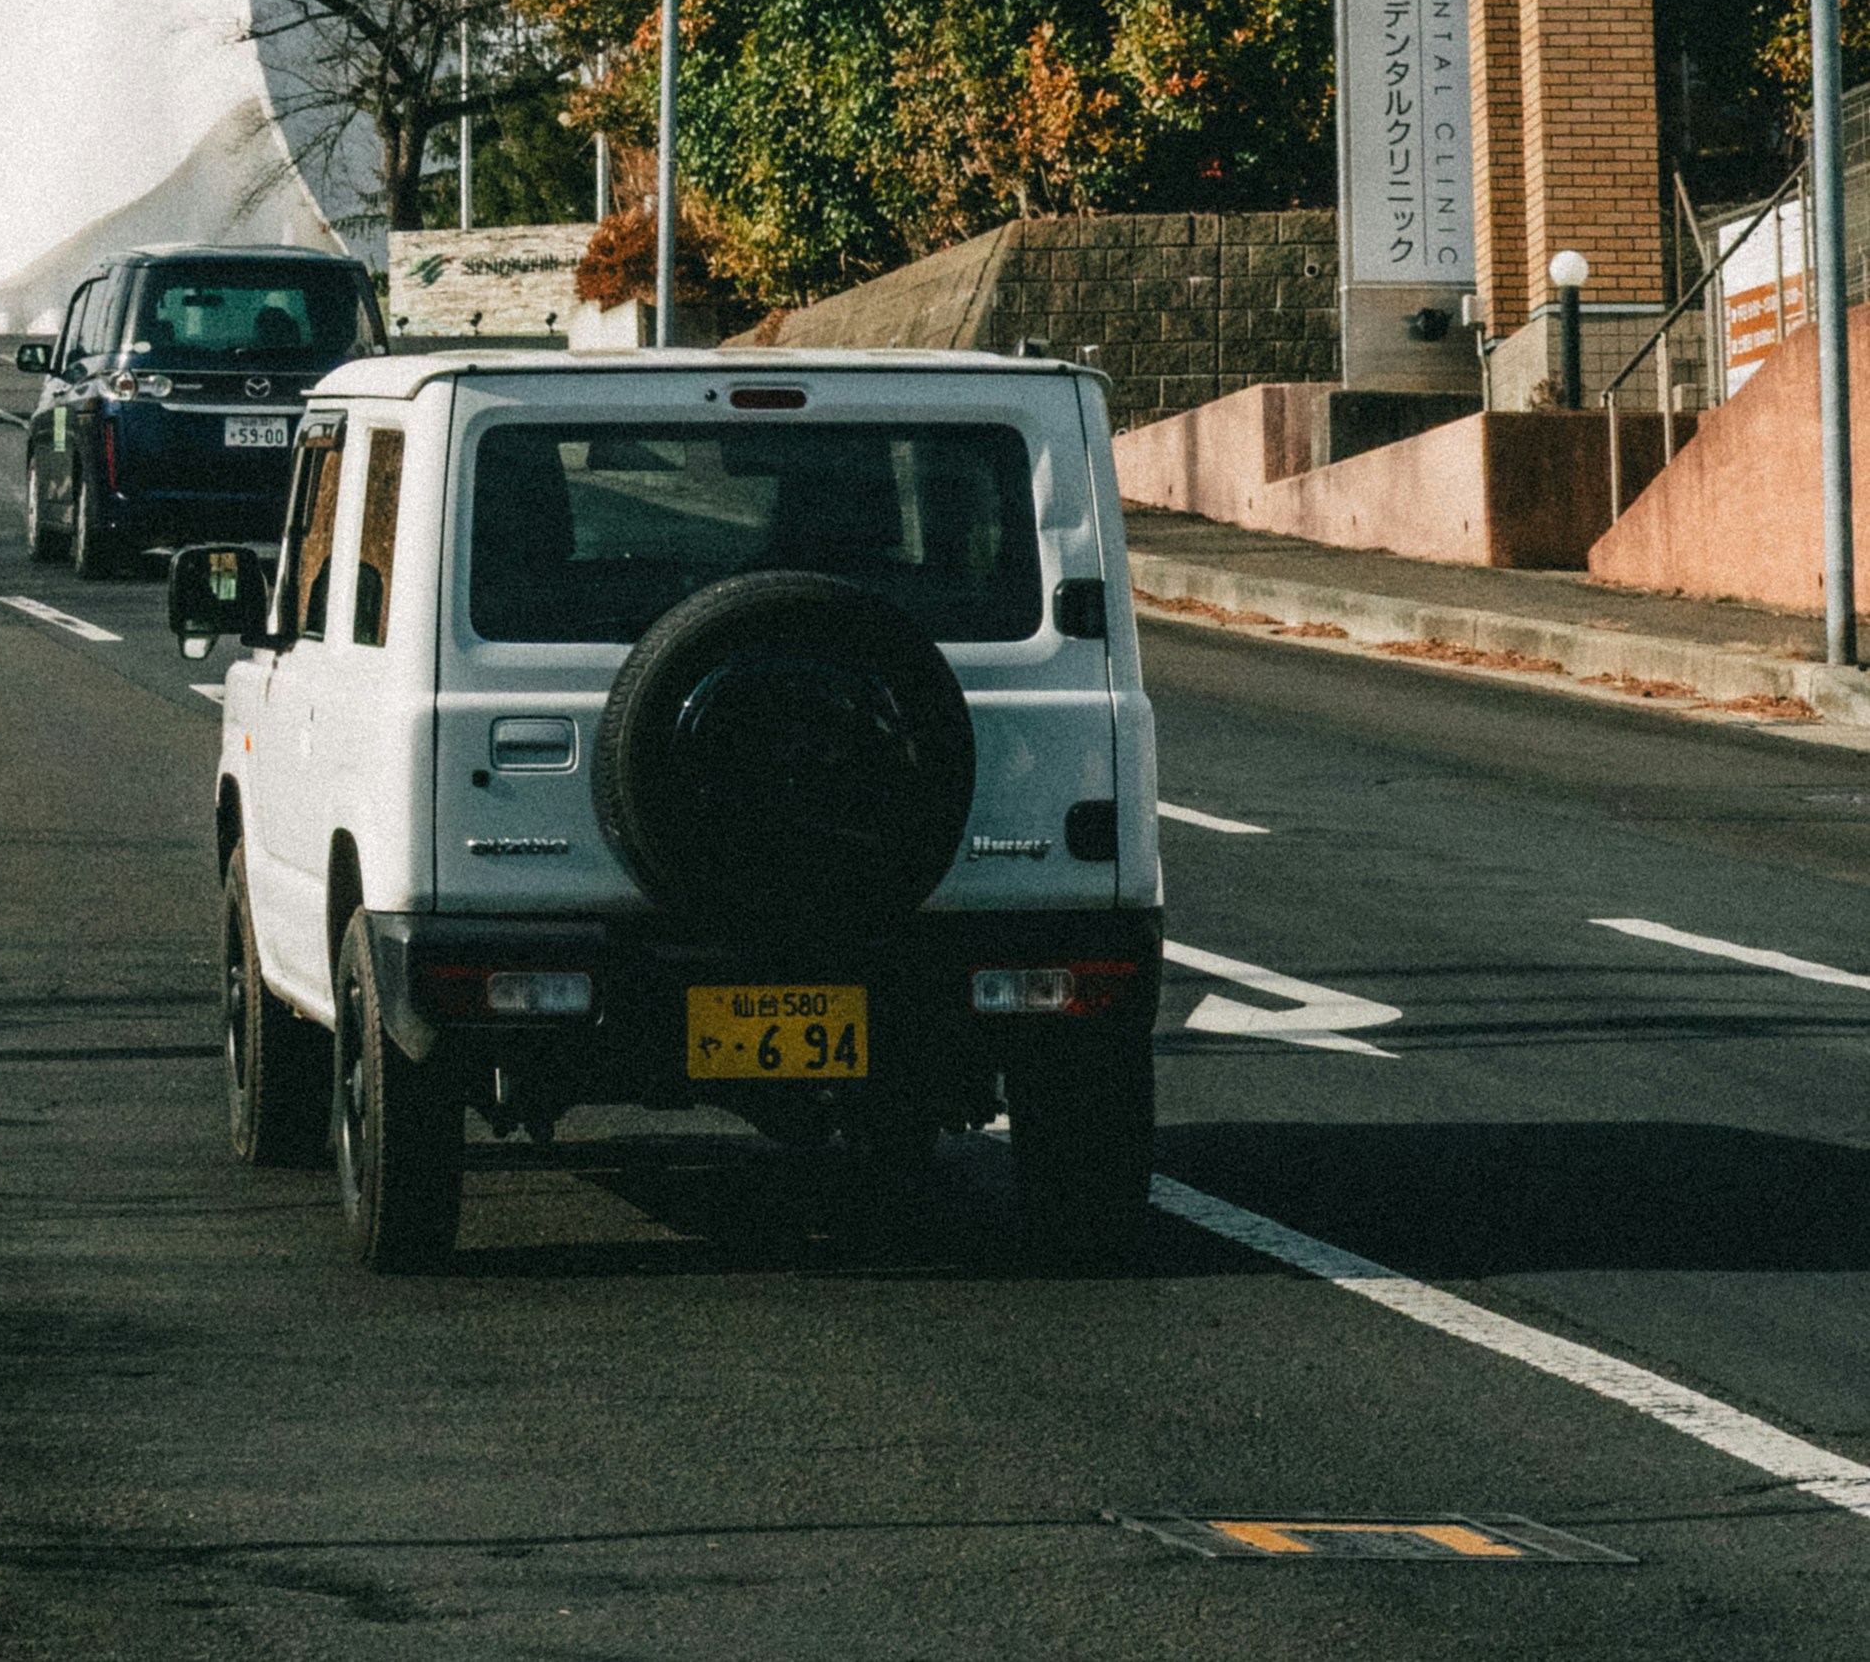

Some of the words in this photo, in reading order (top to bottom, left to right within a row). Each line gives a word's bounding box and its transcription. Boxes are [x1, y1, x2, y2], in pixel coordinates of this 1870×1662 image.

[1383, 0, 1415, 263] デンタルクリニック
[1434, 123, 1458, 264] CLINIC
[238, 427, 284, 445] 59-00
[783, 992, 828, 1017] 580
